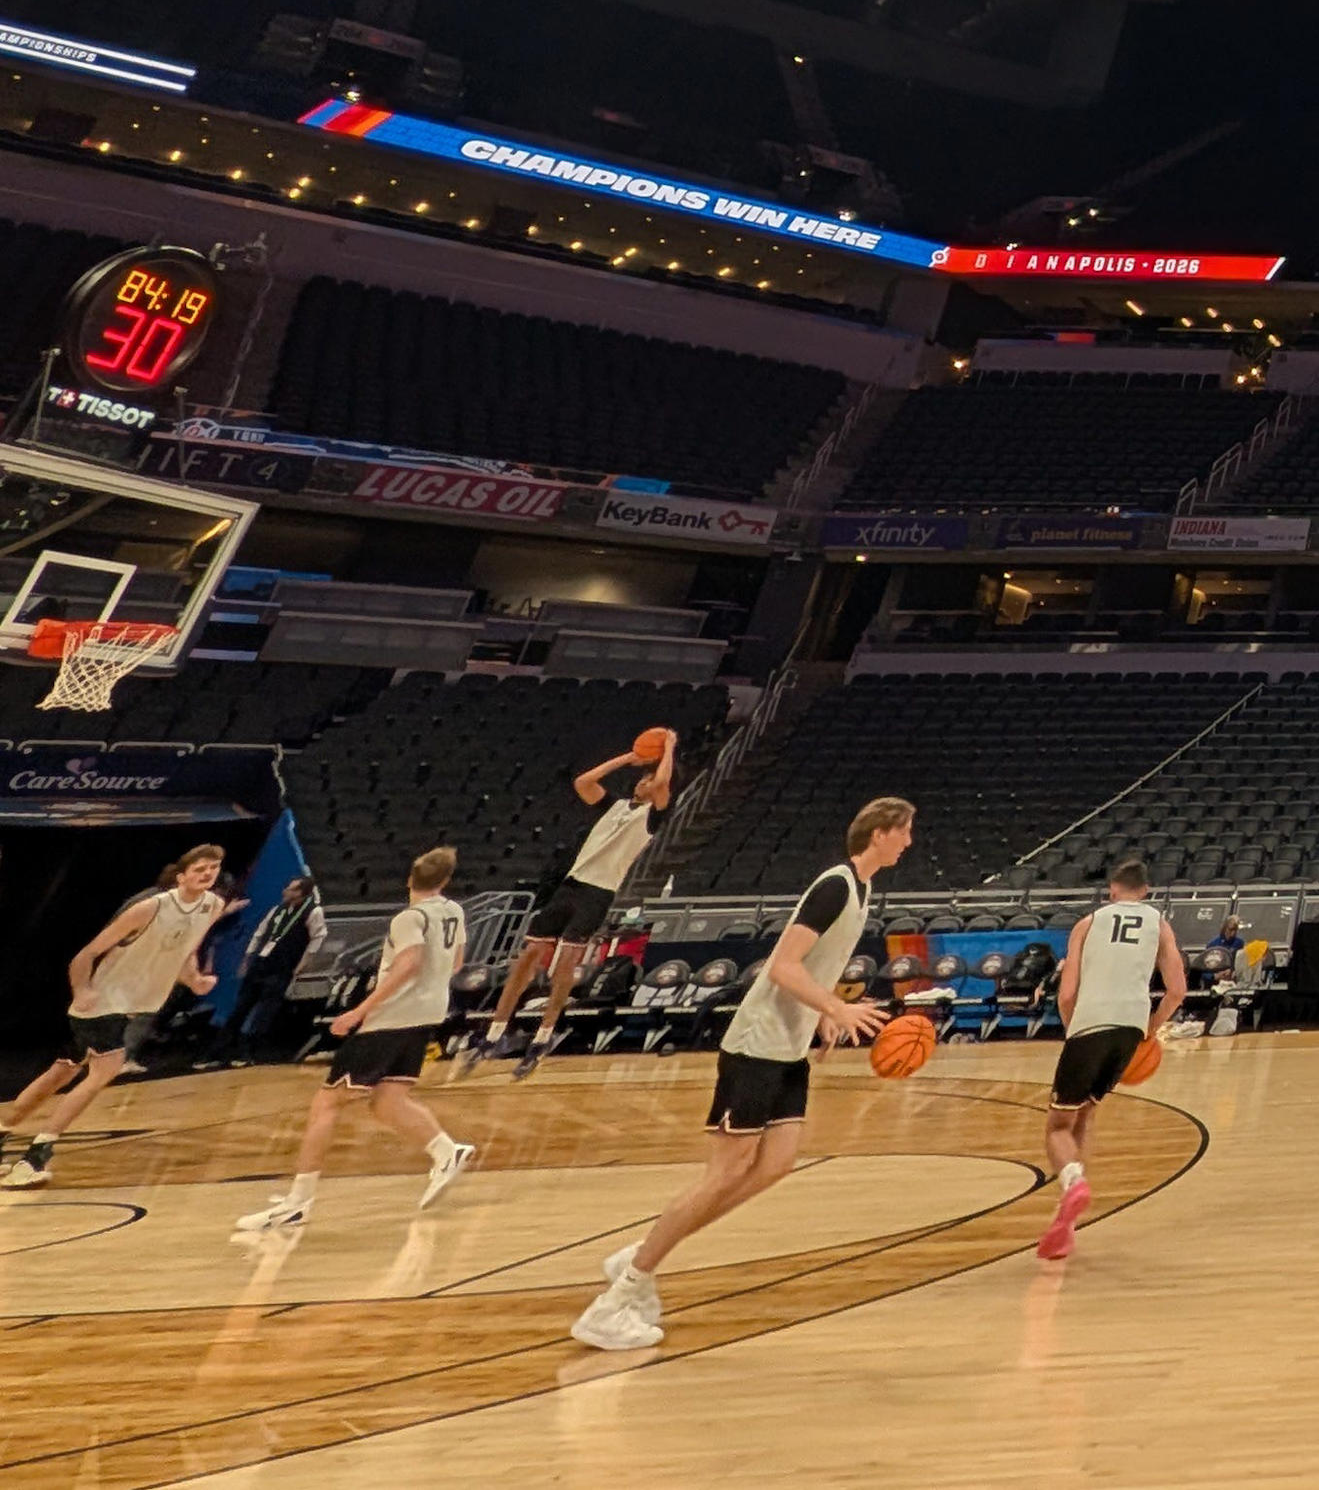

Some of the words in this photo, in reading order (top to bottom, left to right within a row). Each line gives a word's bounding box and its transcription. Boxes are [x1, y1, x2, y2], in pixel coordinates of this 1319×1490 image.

[460, 139, 710, 211] CHAMPIONS
[713, 197, 787, 232] WIN
[787, 221, 882, 251] HERE
[1153, 258, 1200, 275] 2026
[117, 270, 207, 324] 84:19
[86, 306, 182, 380] 30
[77, 394, 156, 428] TISSOT
[354, 467, 500, 510] LUCAS
[502, 485, 564, 517] OIL
[603, 500, 713, 531] KeyBank
[1174, 521, 1226, 535] INDIANA
[855, 521, 936, 546] xfinity
[1031, 528, 1079, 543] planet
[9, 770, 168, 790] CareSource
[1111, 914, 1143, 944] 12
